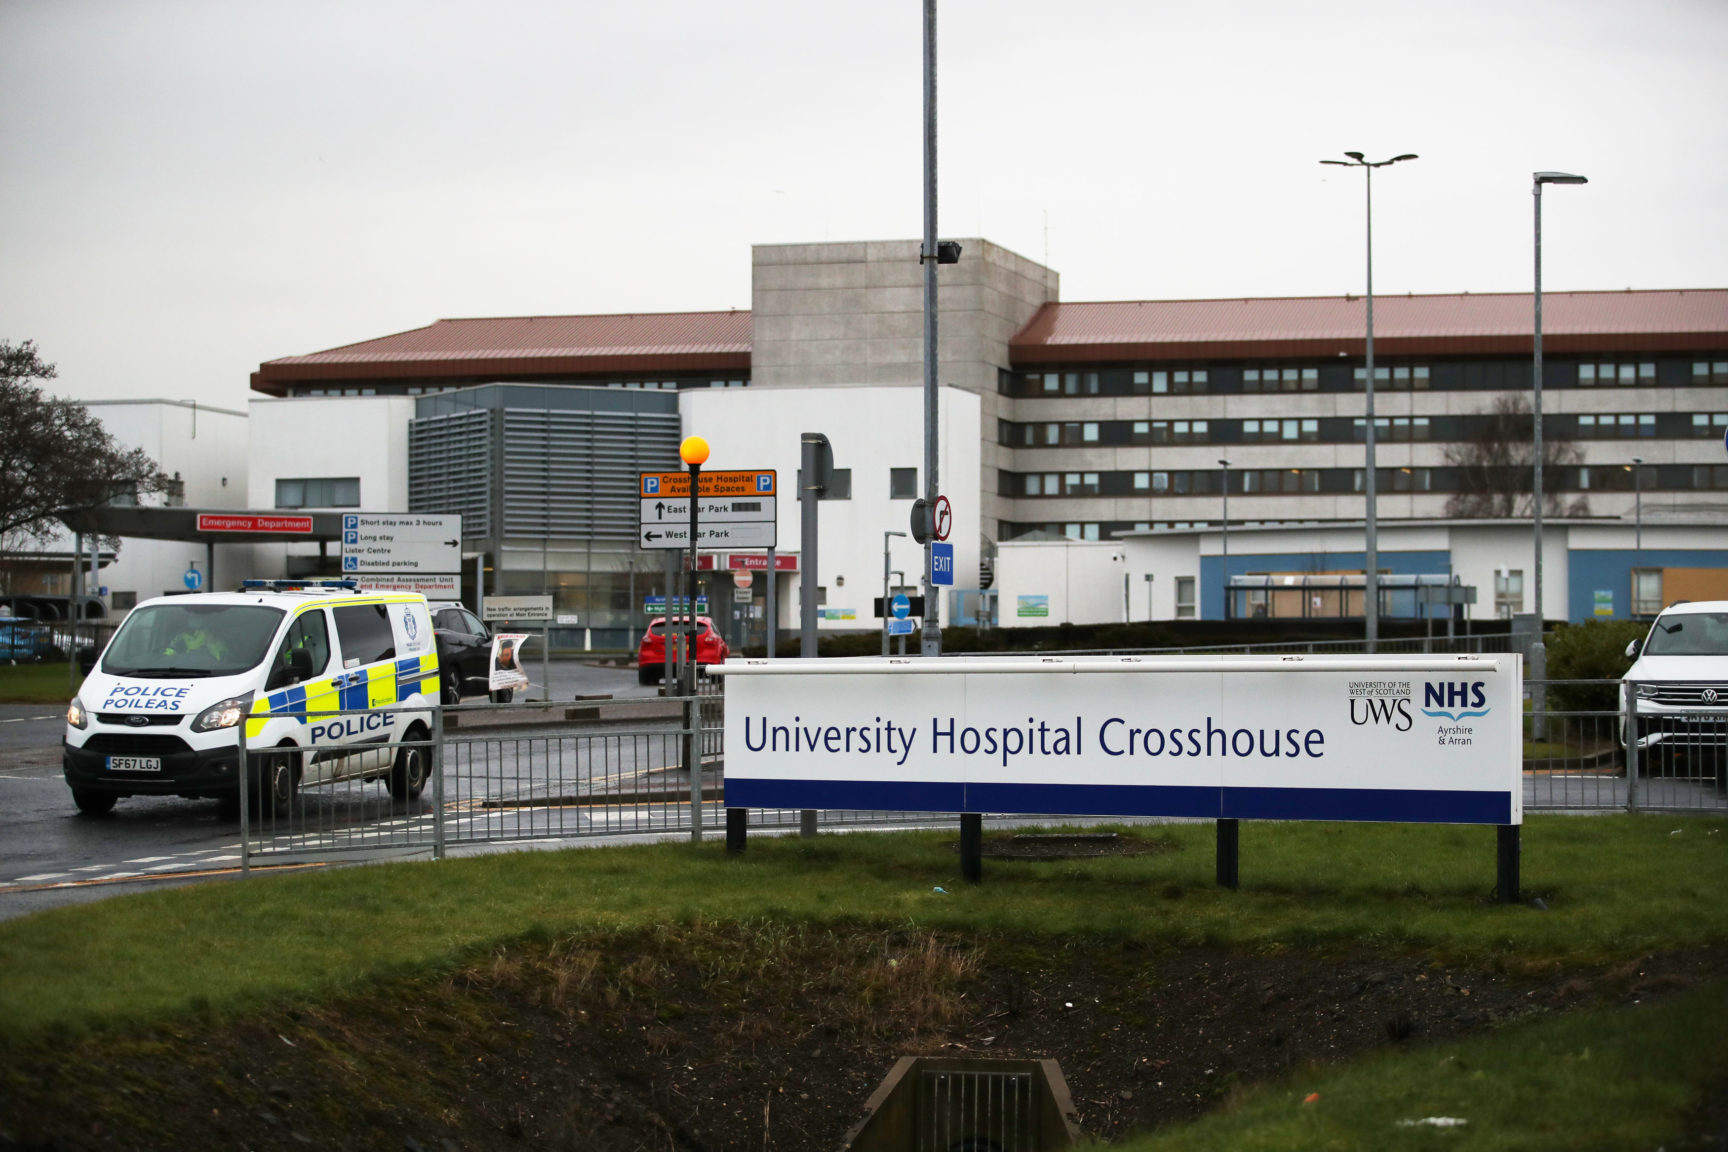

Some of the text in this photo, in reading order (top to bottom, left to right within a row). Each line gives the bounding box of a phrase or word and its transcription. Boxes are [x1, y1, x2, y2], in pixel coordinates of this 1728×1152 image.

[662, 476, 712, 484] Crosshuse
[717, 474, 753, 482] Hospital
[714, 484, 746, 493] Spaces
[667, 506, 687, 514] East
[708, 504, 728, 512] Park
[202, 517, 310, 530] Emergency Department
[382, 520, 397, 528] stay
[665, 530, 688, 538] West
[709, 530, 730, 538] Park
[360, 560, 418, 568] Disabled parking
[934, 556, 950, 572] EXIT
[376, 583, 412, 591] Emergency
[415, 583, 454, 591] Department
[109, 686, 190, 698] POLICE
[1366, 688, 1374, 696] of
[1424, 681, 1486, 708] NHS
[102, 698, 182, 710] POILEAS
[1349, 698, 1413, 732] UWS
[310, 712, 395, 744] POLICE
[1438, 726, 1472, 737] Ayrshire
[744, 715, 1325, 766] University Hospital Crosshouse
[1438, 737, 1472, 745] & Arran
[112, 758, 159, 770] SF67 LGJ
